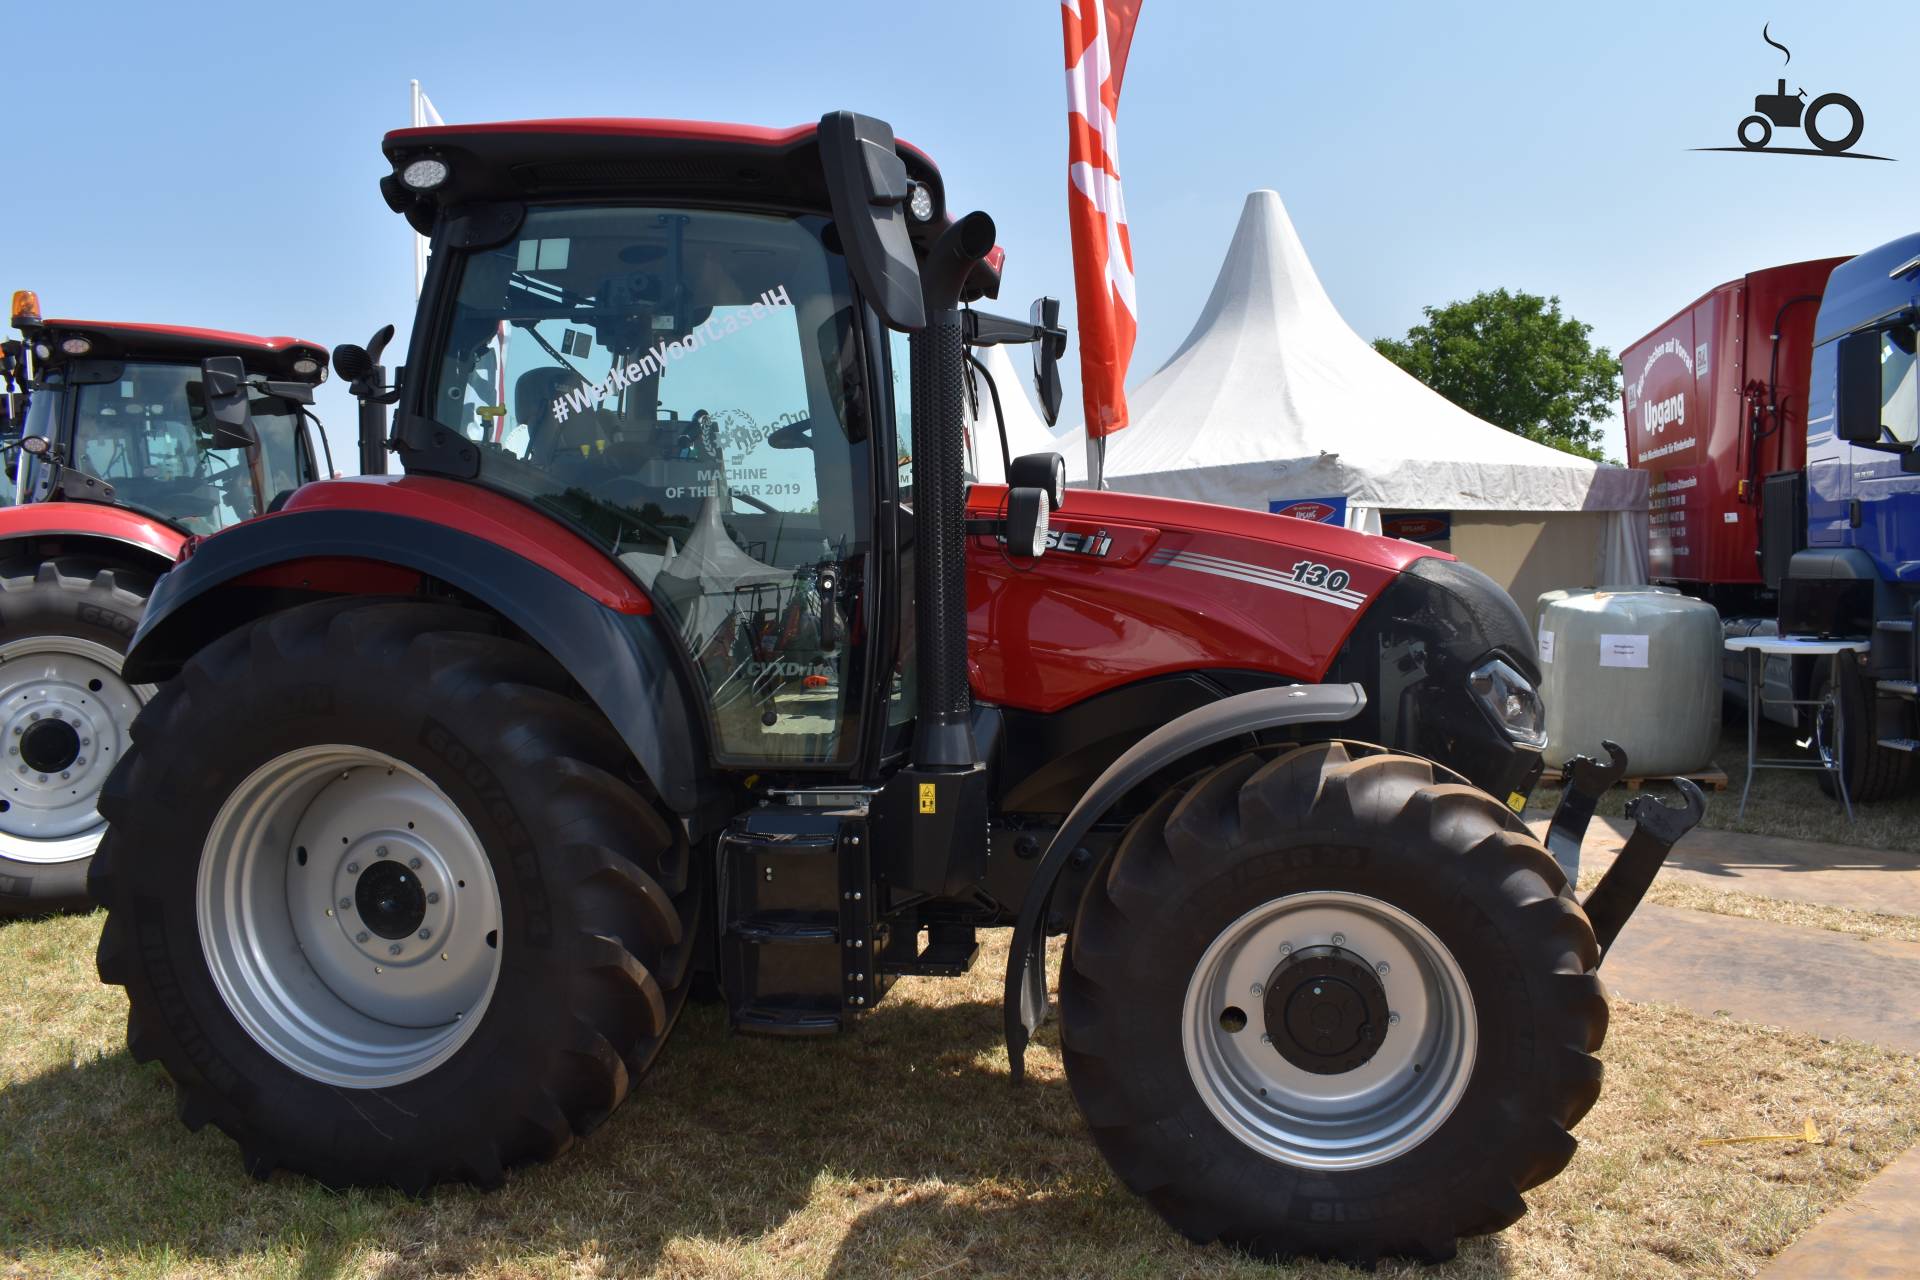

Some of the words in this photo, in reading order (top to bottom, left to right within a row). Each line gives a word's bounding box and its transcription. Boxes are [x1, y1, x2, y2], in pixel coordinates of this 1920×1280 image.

[552, 285, 792, 424] #WerkenVoorCaseIH
[1644, 393, 1684, 436] Upgang
[665, 487, 685, 499] OF
[688, 486, 716, 498] THE
[721, 484, 761, 497] YEAR
[765, 483, 800, 495] 2019
[697, 468, 767, 481] MACHINE
[1291, 560, 1350, 593] 130
